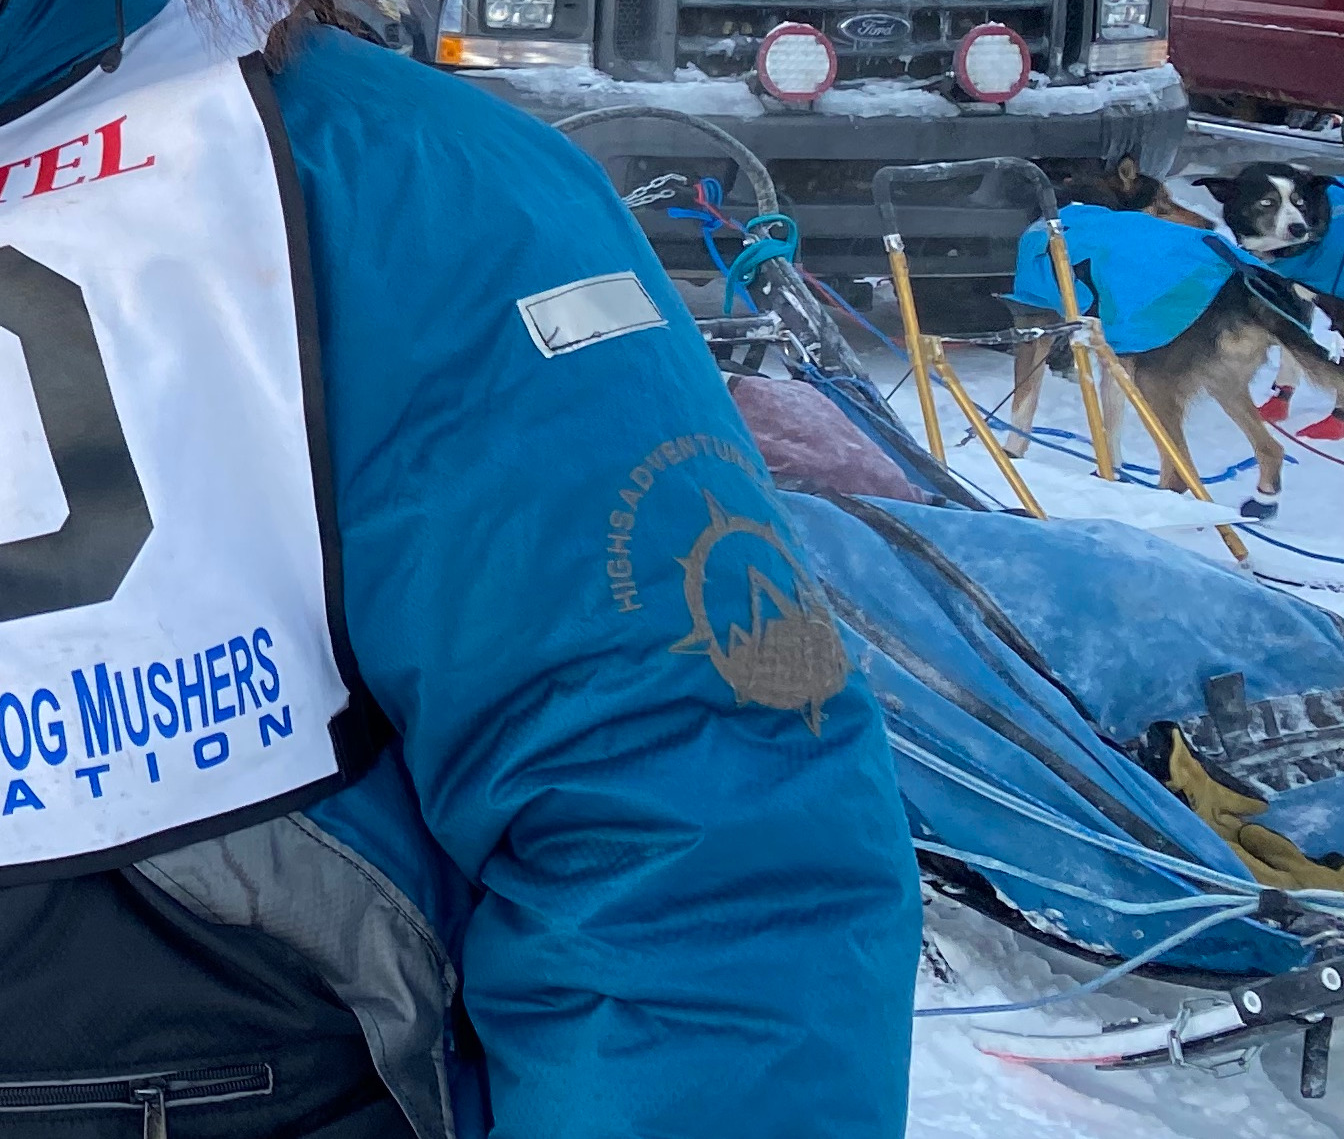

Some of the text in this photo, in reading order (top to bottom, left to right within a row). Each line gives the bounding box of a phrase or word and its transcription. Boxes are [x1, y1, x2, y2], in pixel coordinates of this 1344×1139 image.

[857, 19, 896, 36] Ford
[606, 510, 643, 613] HIGHS
[70, 626, 282, 760] MUSHERS
